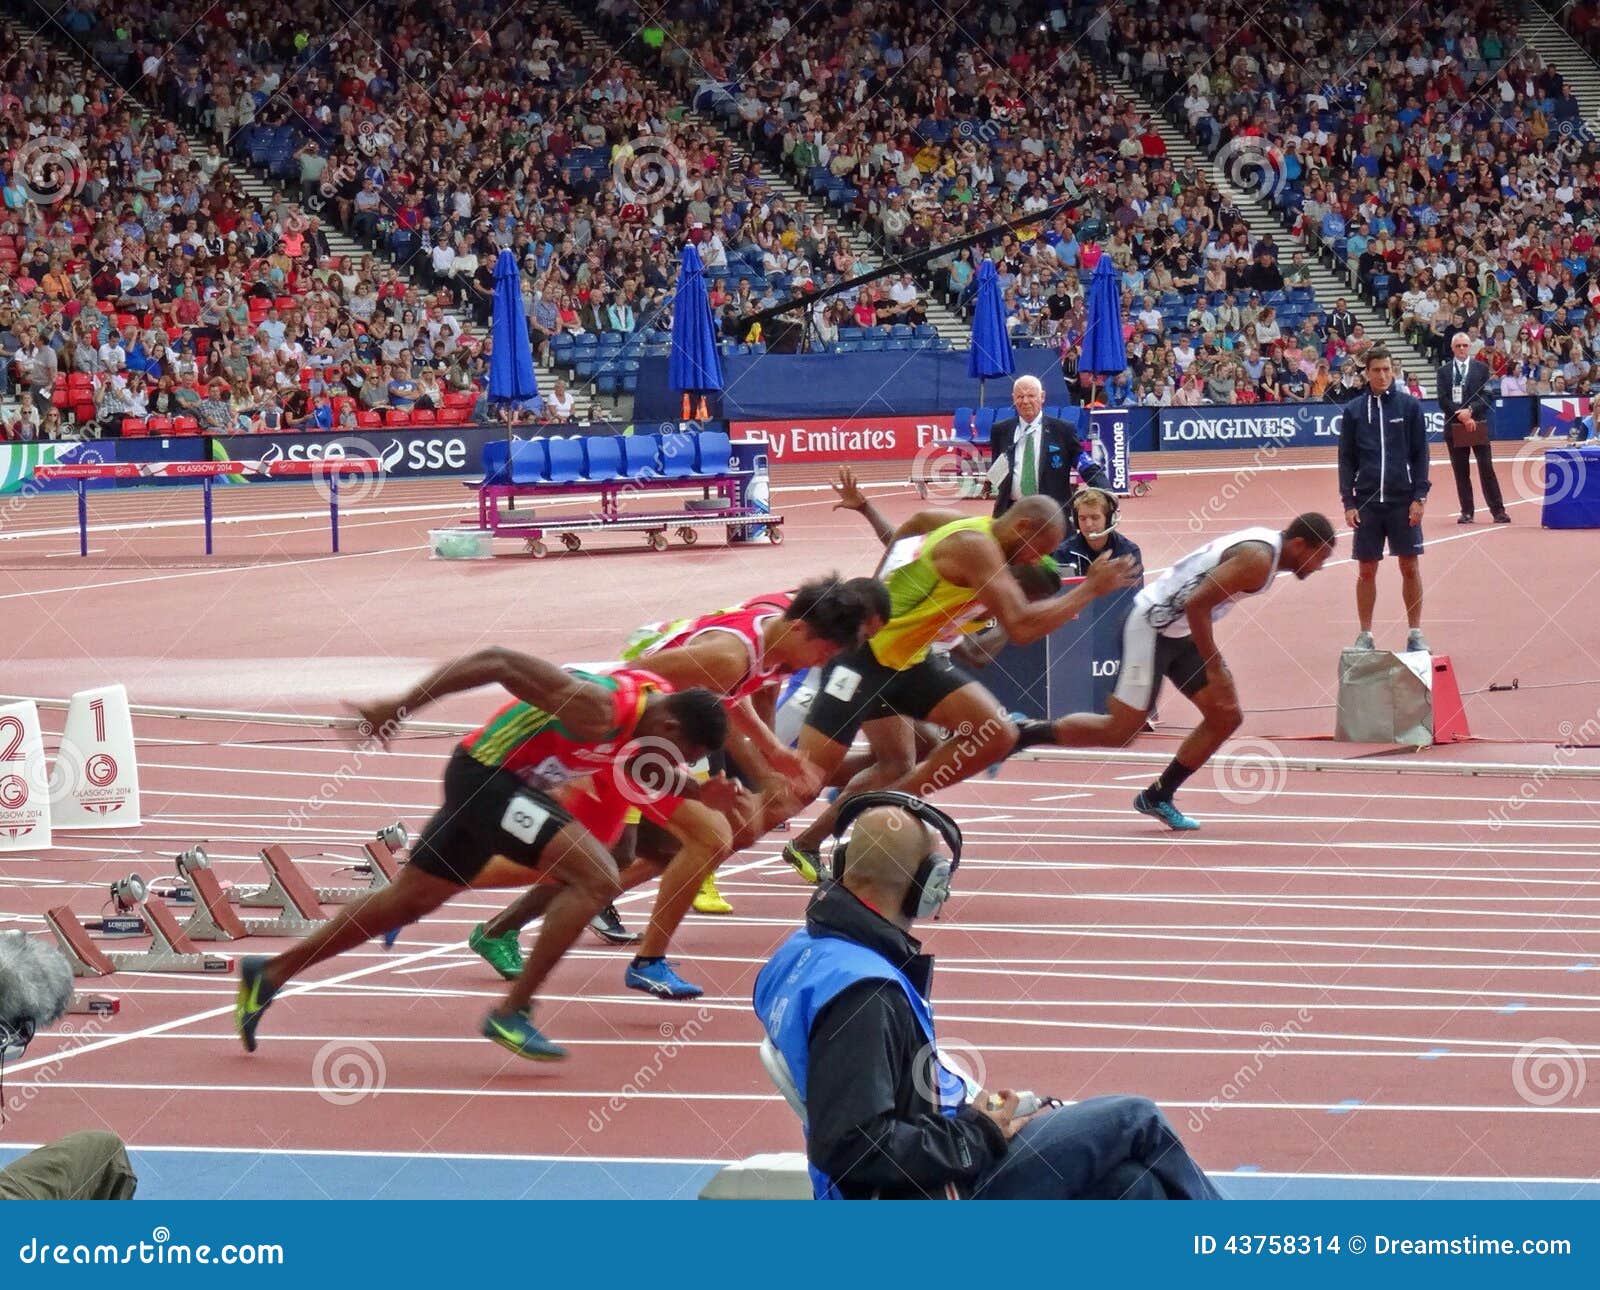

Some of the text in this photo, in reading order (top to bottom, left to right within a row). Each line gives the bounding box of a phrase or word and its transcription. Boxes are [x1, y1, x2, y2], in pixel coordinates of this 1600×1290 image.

[790, 426, 896, 453] Emirates
[1163, 417, 1296, 441] LONGINES
[177, 463, 232, 473] GLASGOW 2014
[408, 439, 466, 469] sse
[1112, 422, 1126, 489] Strathmore
[89, 699, 104, 742] 1
[0, 715, 26, 761] 2
